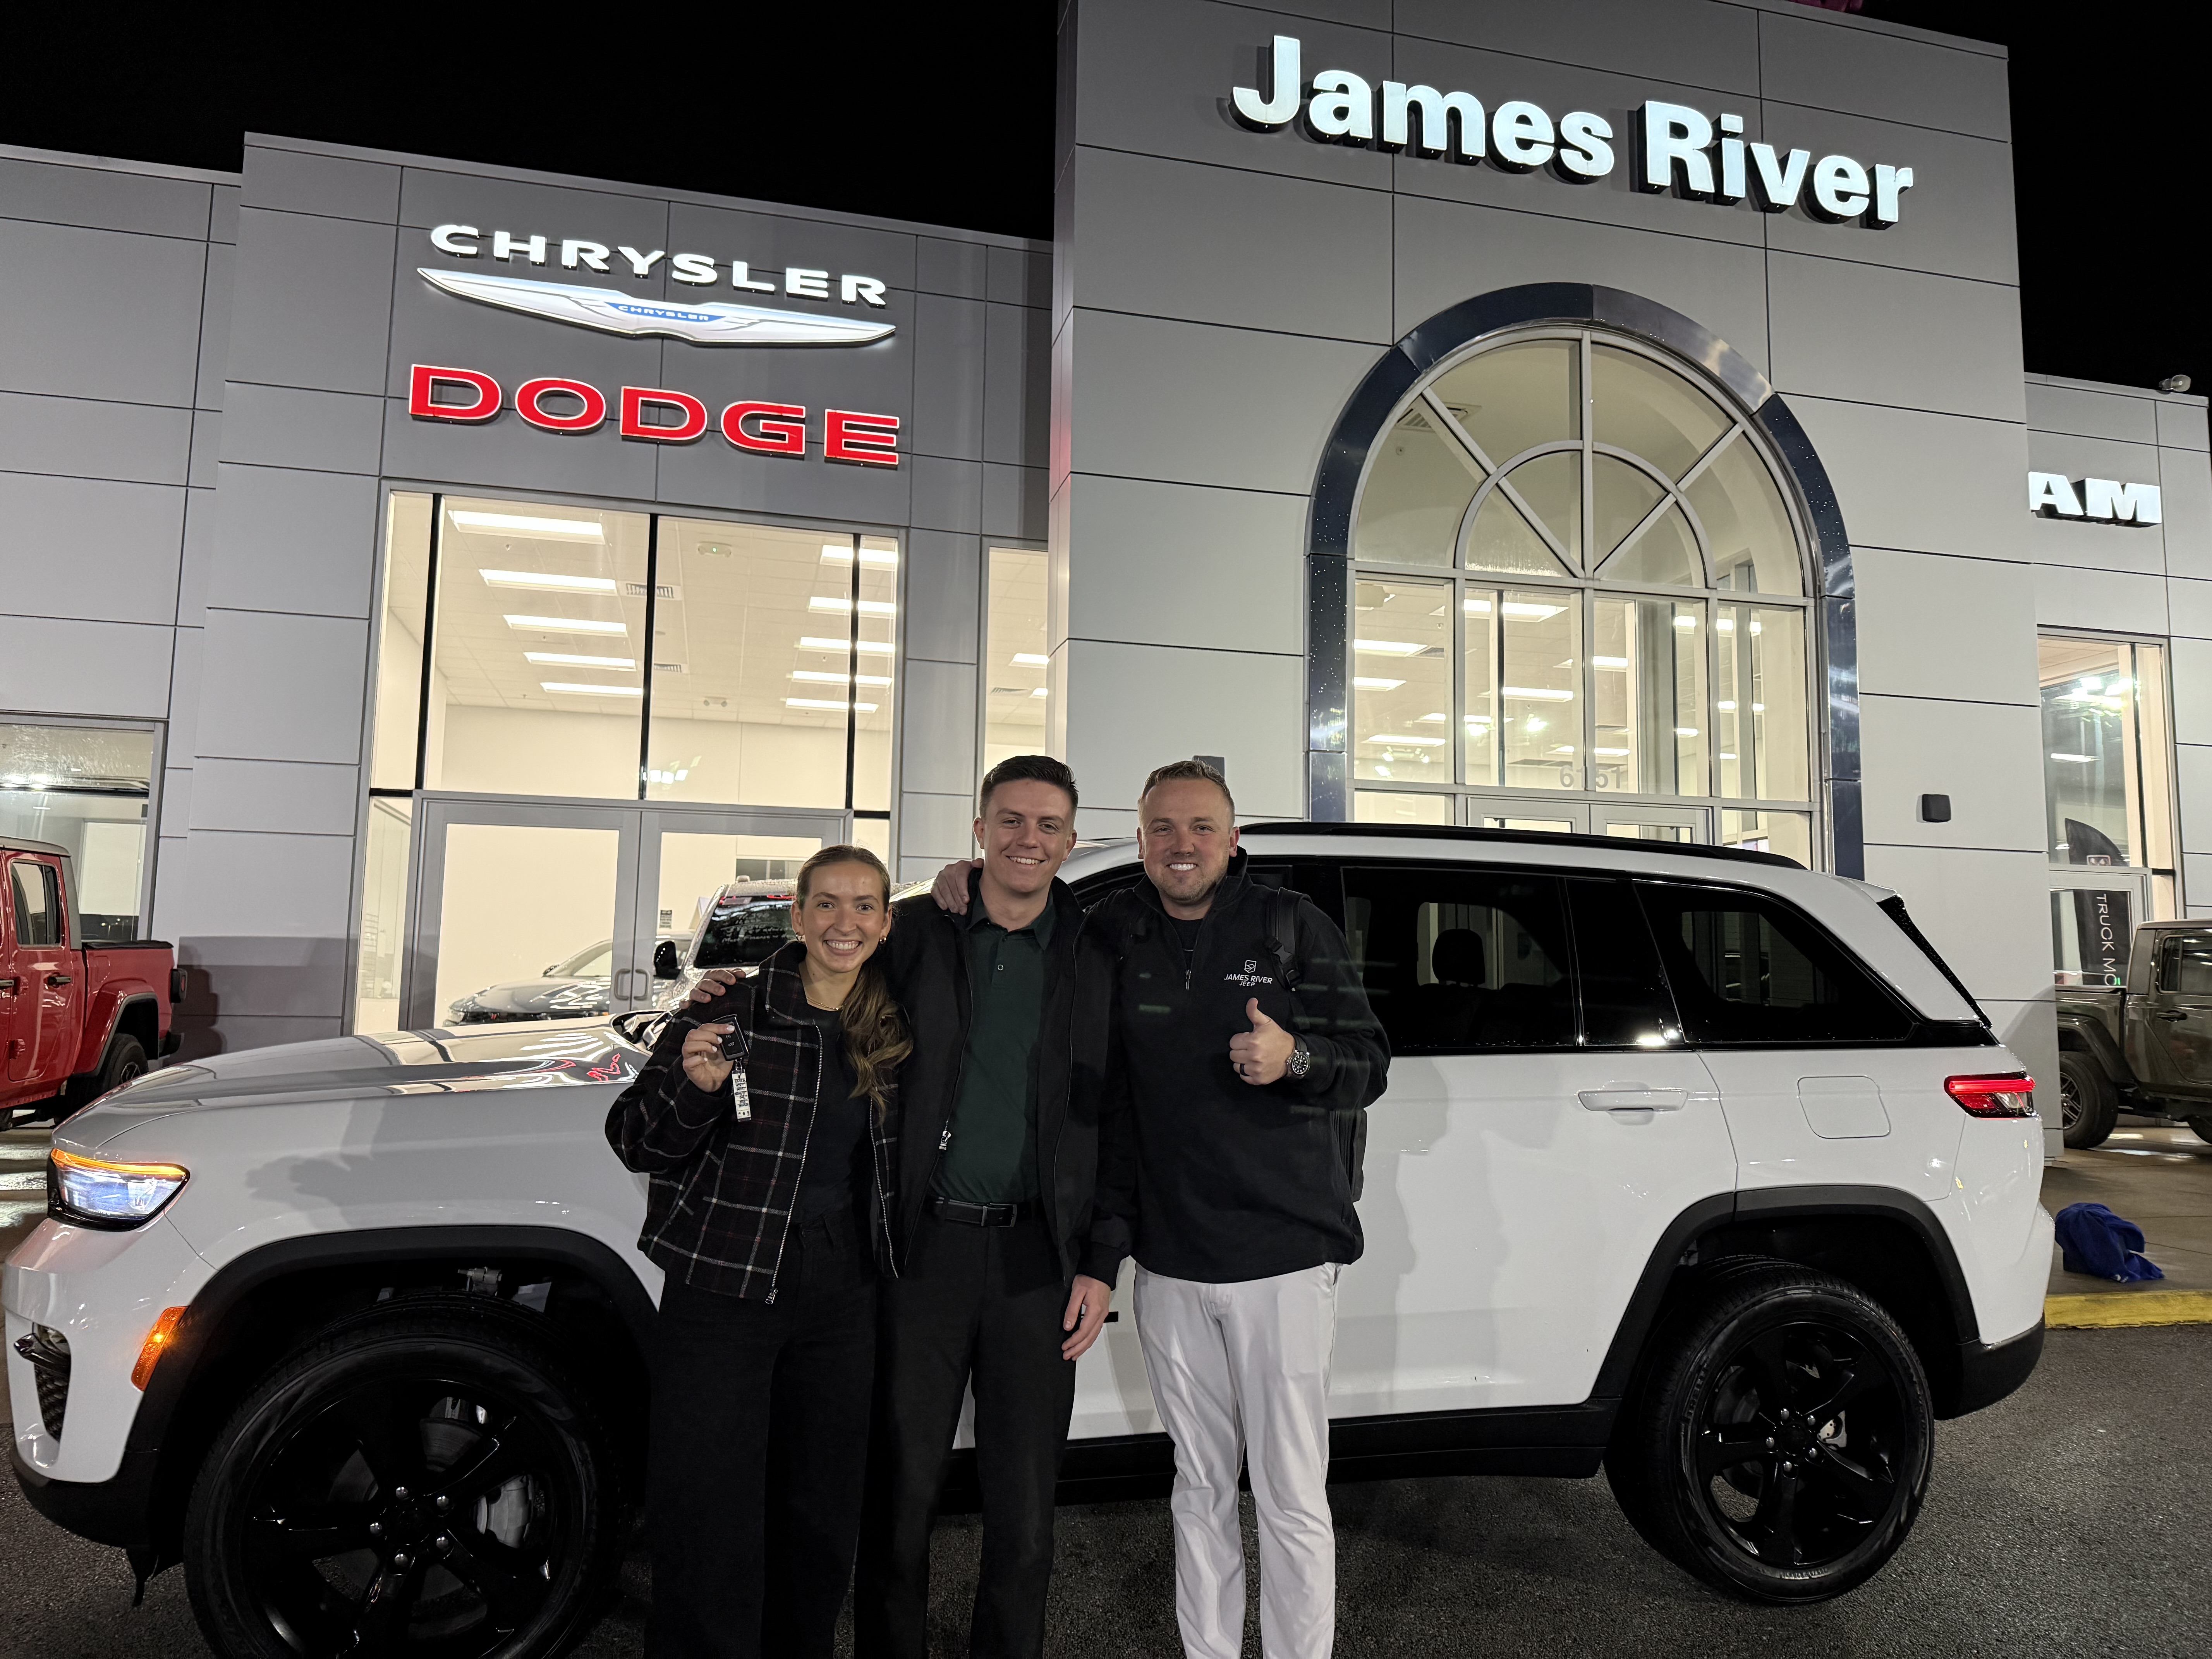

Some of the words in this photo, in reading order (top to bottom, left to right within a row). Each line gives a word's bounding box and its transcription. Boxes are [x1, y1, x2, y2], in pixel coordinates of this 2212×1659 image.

[1231, 34, 1615, 176] James
[1644, 100, 1914, 223] River
[431, 225, 886, 306] CHRYSLER
[618, 306, 709, 321] CHRYSLER
[408, 364, 900, 464] DODGE
[1559, 764, 1621, 789] 6151
[2096, 893, 2115, 951] TRUCK
[1250, 975, 1273, 984] RIVER
